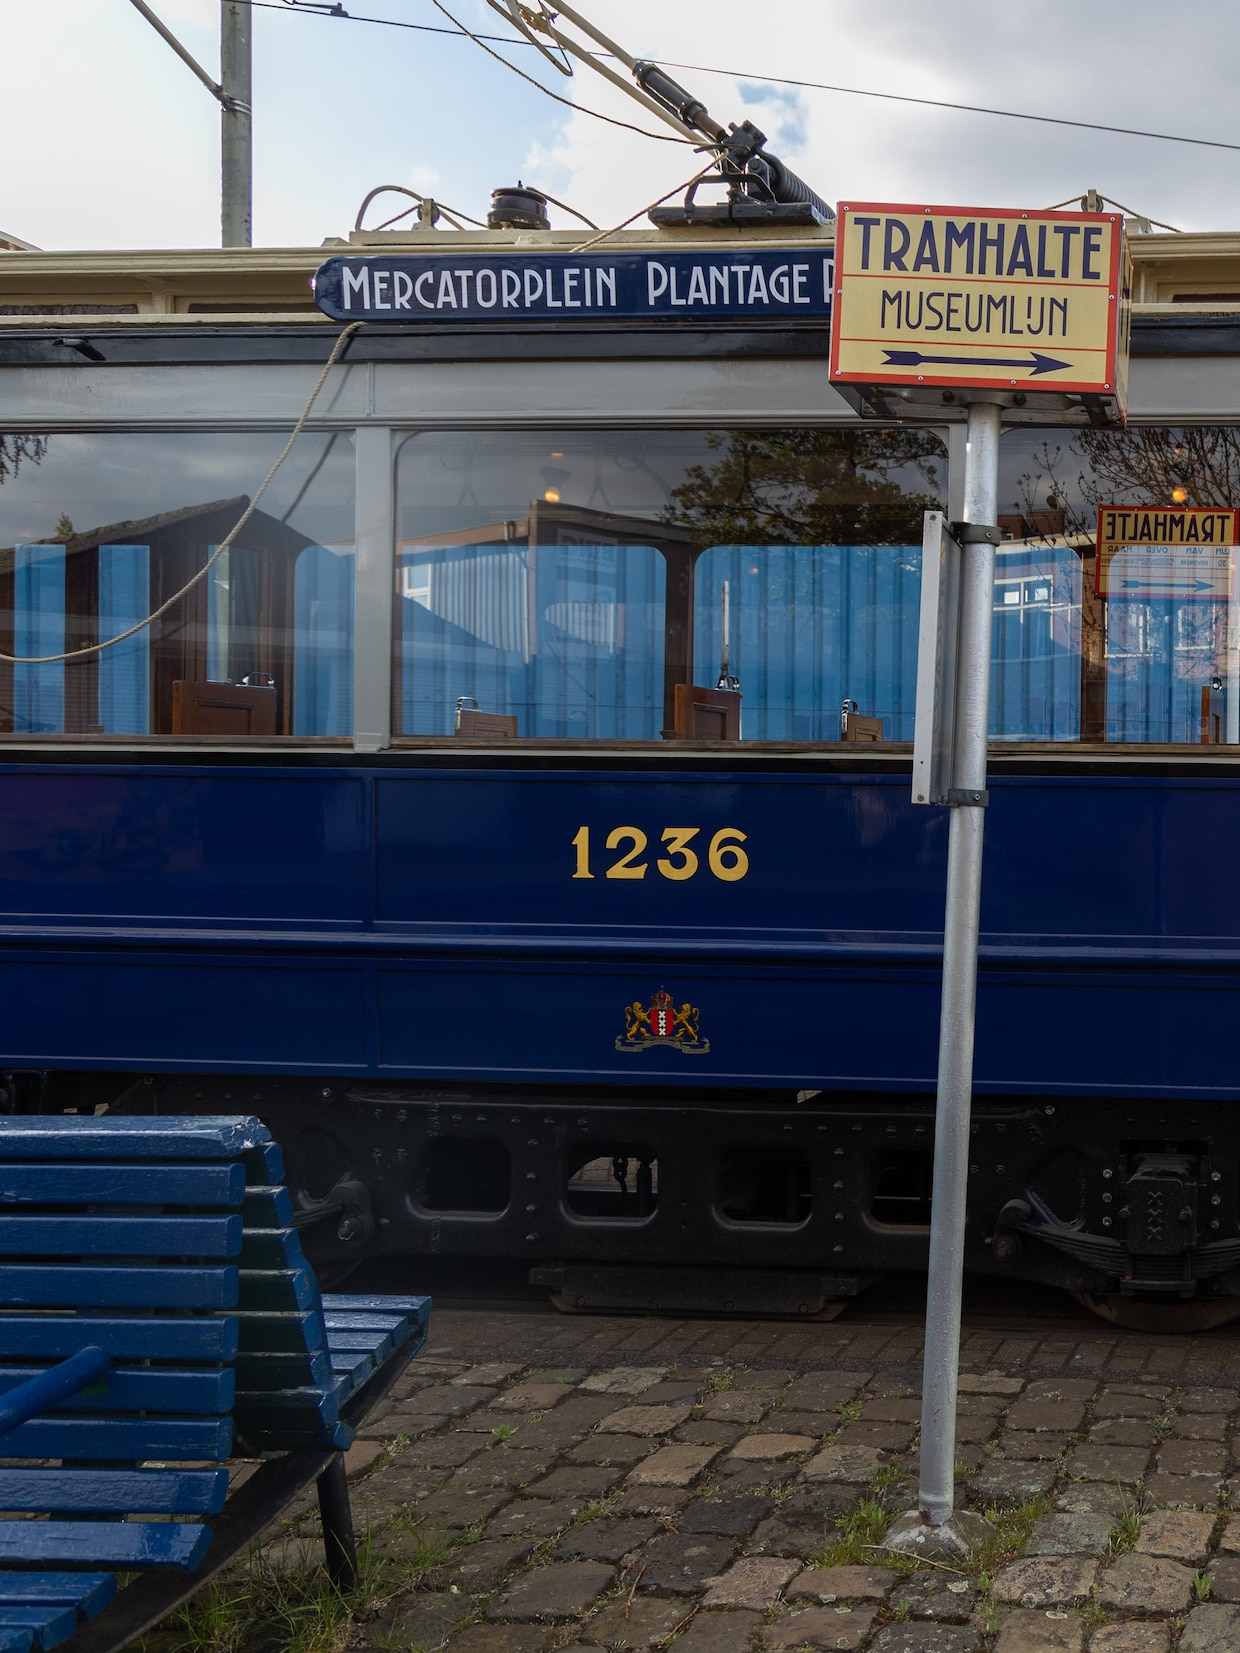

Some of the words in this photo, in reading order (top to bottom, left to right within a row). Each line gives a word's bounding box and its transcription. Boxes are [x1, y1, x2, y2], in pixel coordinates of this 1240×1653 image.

[852, 216, 1102, 281] TRAMHALTE
[342, 265, 617, 310] MERCATORPLEIN
[646, 260, 811, 306] PLANTAGE
[880, 289, 1069, 338] MUSEUMLIJN
[571, 825, 749, 882] 1236
